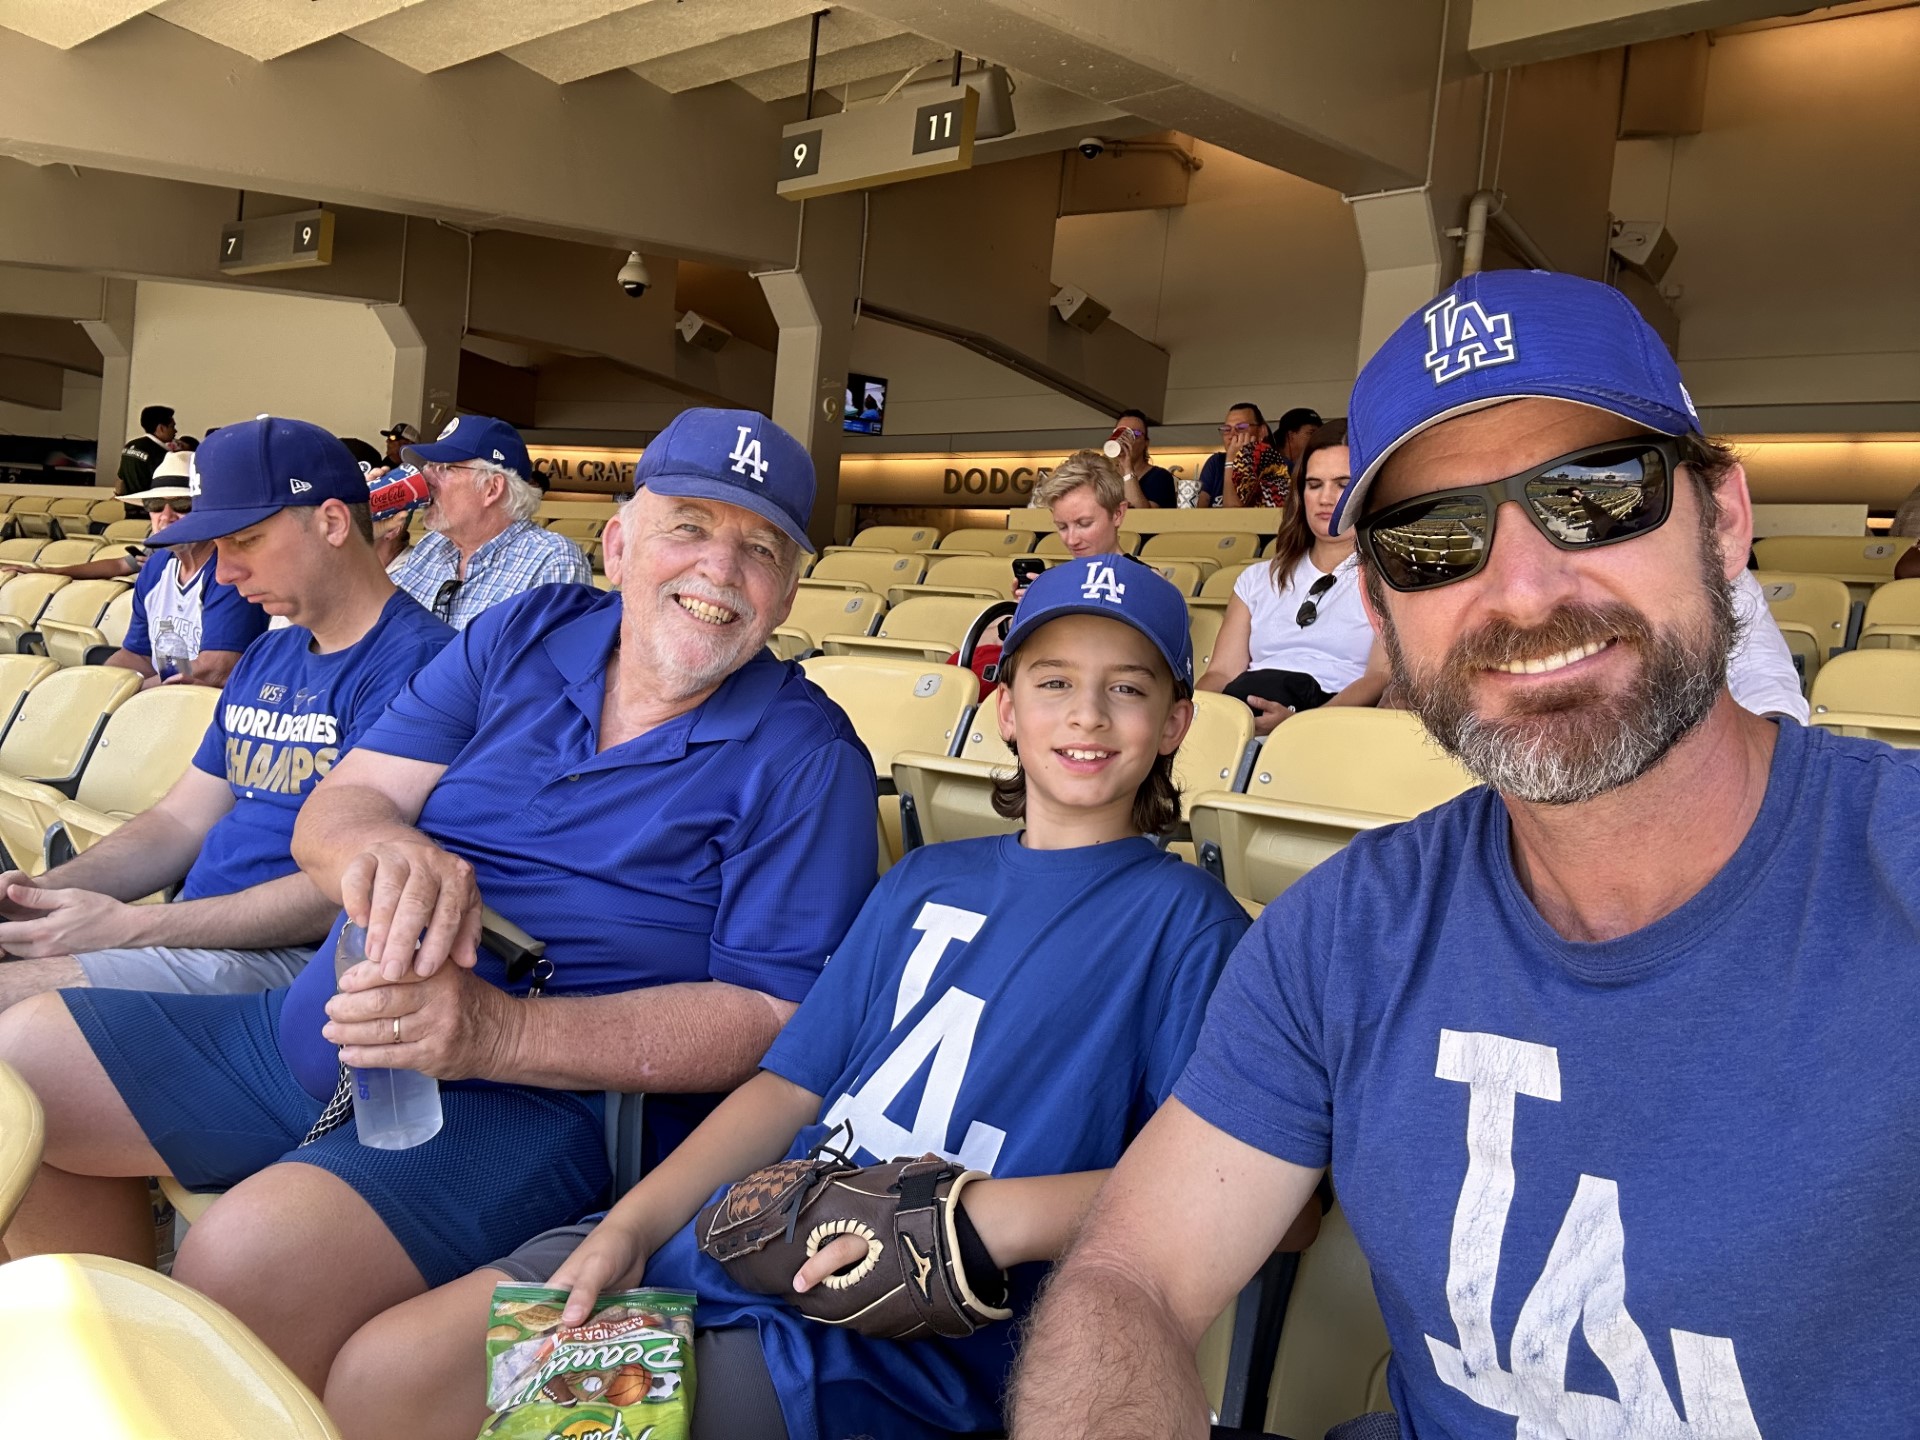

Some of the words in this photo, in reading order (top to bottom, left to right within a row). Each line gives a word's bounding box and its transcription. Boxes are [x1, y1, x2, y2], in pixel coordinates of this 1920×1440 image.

[929, 112, 952, 141] 11
[793, 143, 807, 168] 9
[227, 237, 237, 255] 7
[302, 226, 311, 245] 9
[1423, 294, 1515, 384] LA
[823, 396, 839, 423] 9
[729, 425, 769, 483] LA
[532, 457, 573, 480] CAL
[577, 460, 637, 483] CRAF
[1876, 546, 1884, 555] 8
[1081, 561, 1126, 604] LA
[1772, 586, 1783, 596] 7
[924, 679, 933, 691] 5
[224, 704, 293, 742] WORLD
[1424, 1028, 1763, 1440] LA
[573, 1319, 644, 1341] AMERICA'S
